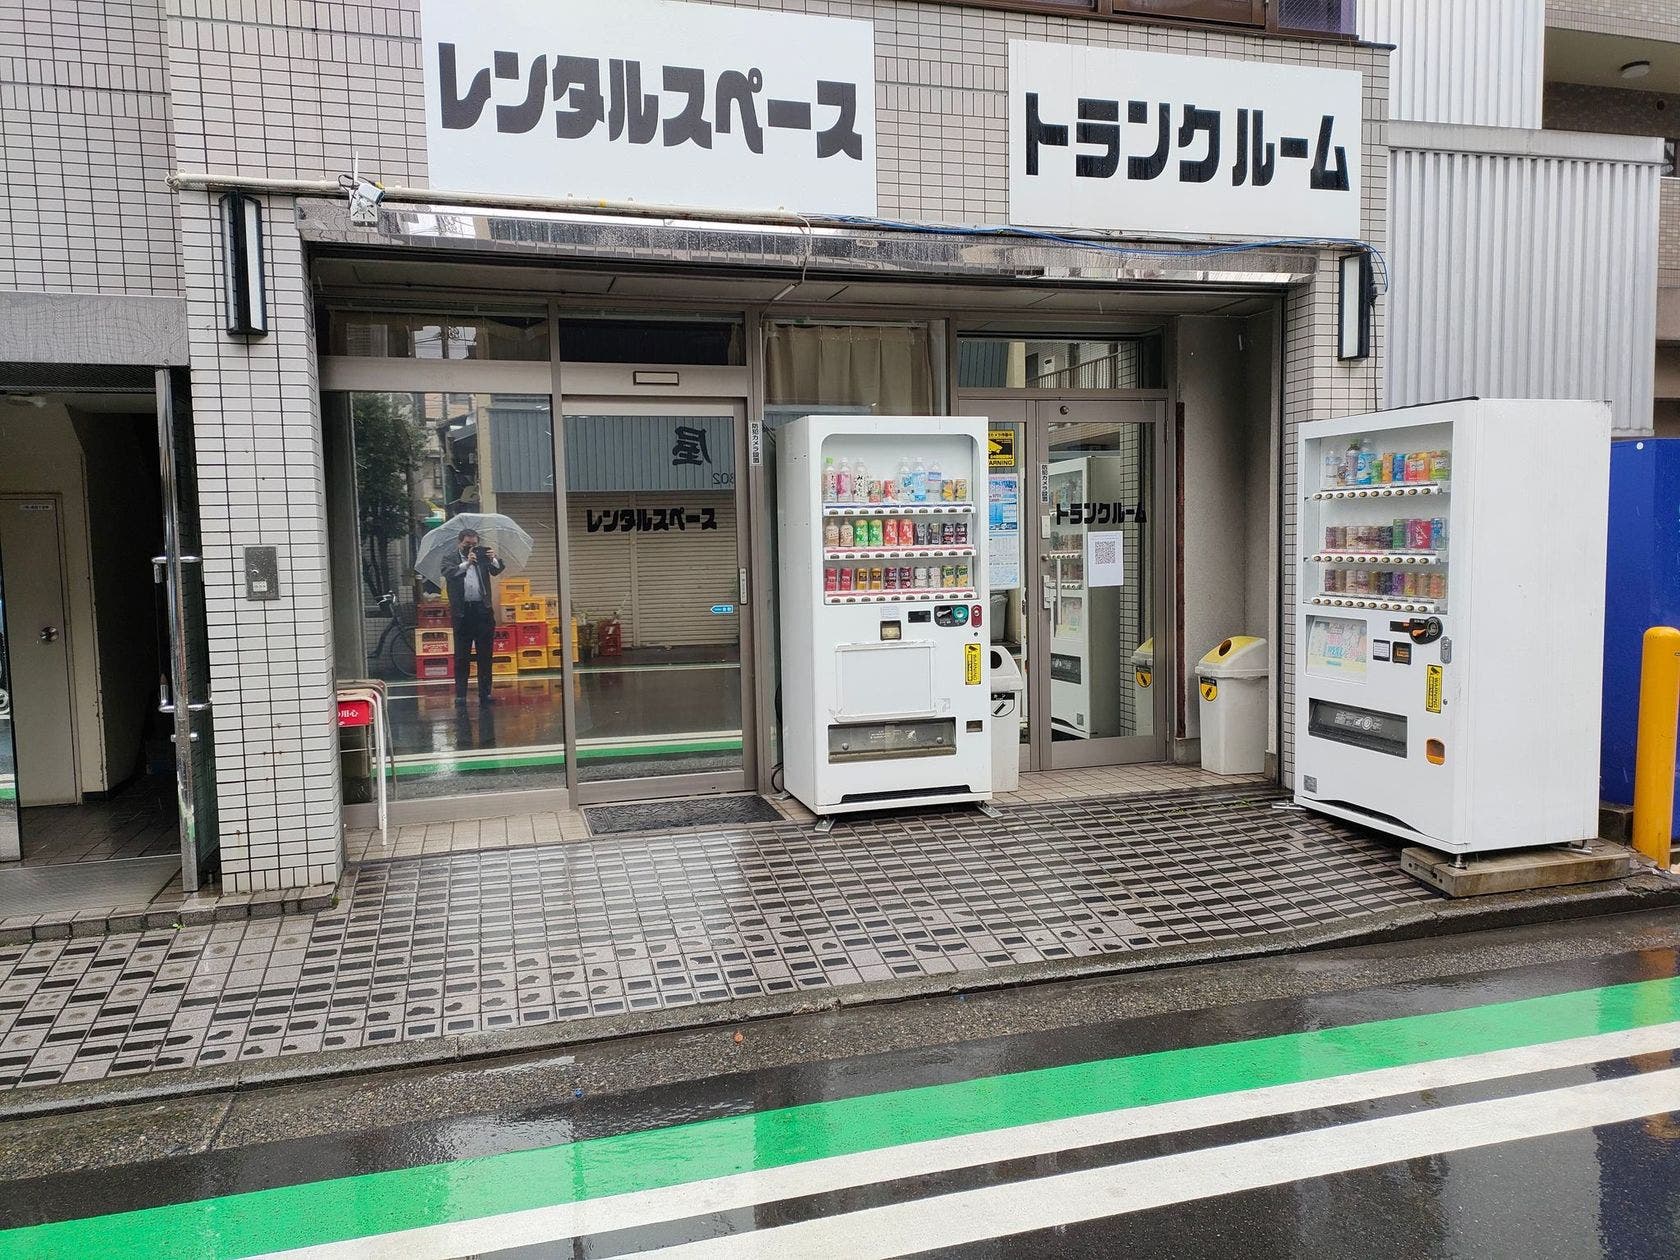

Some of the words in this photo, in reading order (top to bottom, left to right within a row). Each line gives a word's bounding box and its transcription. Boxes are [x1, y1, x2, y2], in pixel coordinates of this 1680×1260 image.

[438, 42, 863, 161] レンタルスペース
[1025, 91, 1350, 191] トランクルーム
[586, 507, 717, 533] レンタルスペース
[1056, 502, 1147, 525] トランクルーム
